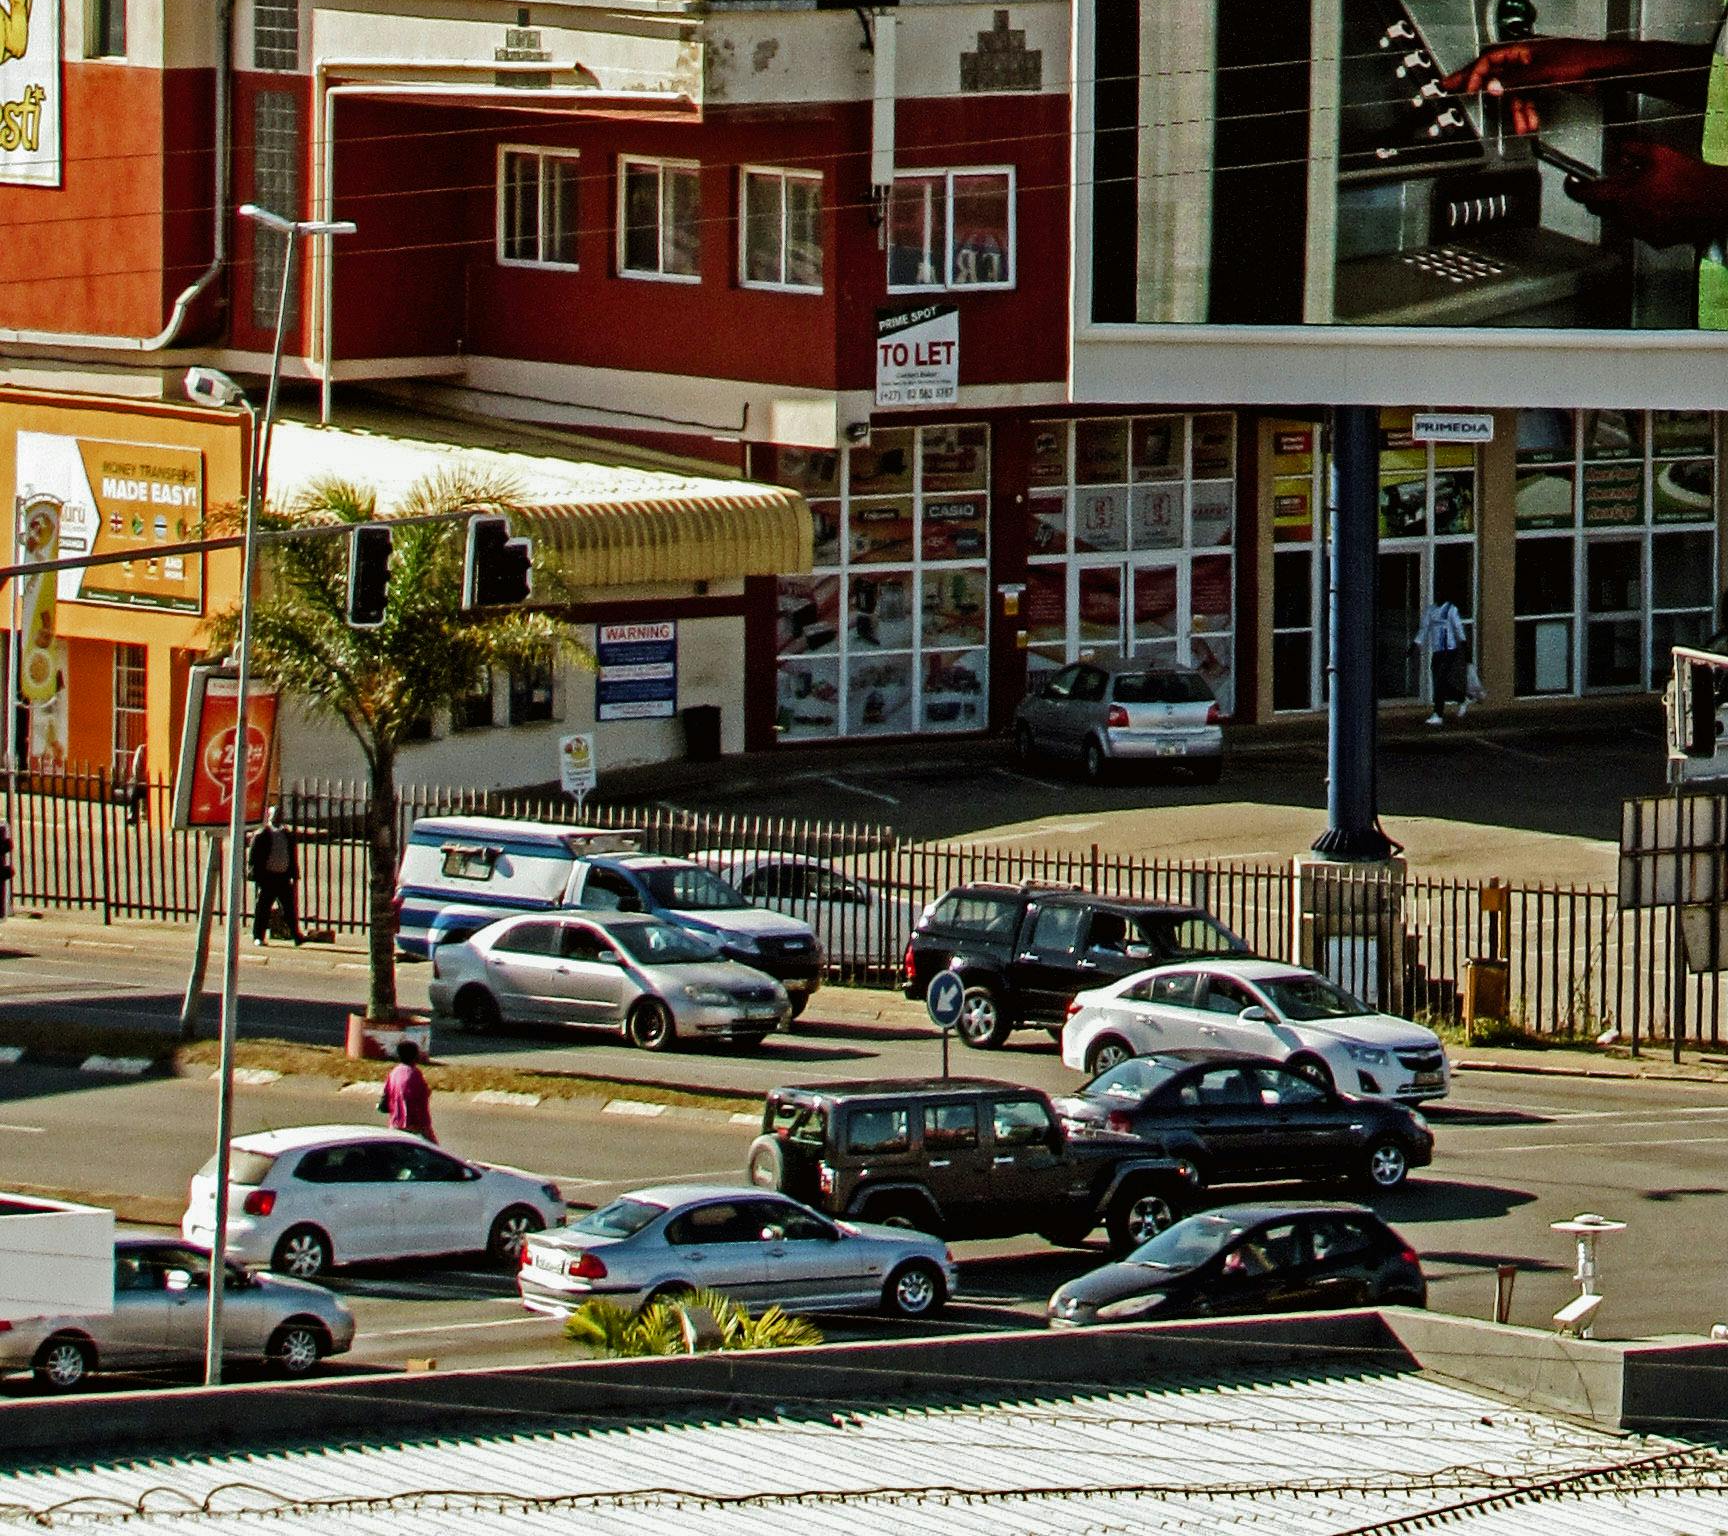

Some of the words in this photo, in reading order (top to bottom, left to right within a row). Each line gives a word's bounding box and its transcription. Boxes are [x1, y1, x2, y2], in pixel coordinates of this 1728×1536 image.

[878, 314, 908, 331] PRIME
[910, 306, 937, 323] SPOT
[880, 342, 909, 367] TO
[914, 340, 956, 366] LET
[1415, 422, 1490, 434] PRIMEDIA
[102, 477, 148, 502] MADE
[152, 482, 198, 507] EASY!
[928, 503, 975, 518] CASIO
[605, 624, 670, 640] WARNING
